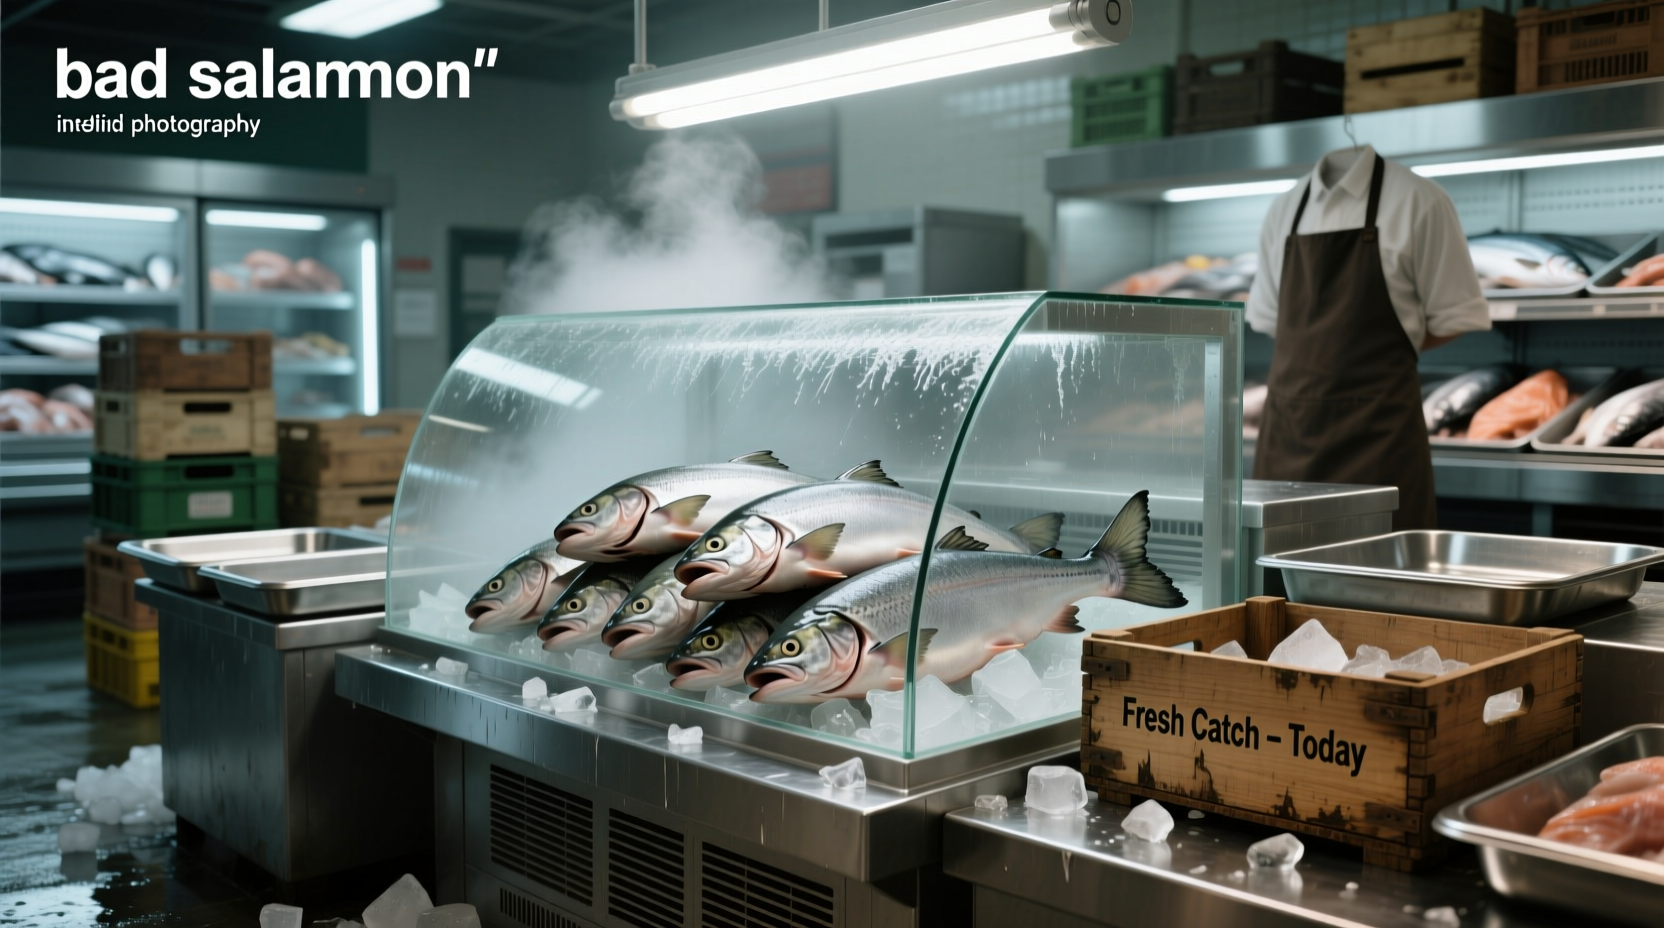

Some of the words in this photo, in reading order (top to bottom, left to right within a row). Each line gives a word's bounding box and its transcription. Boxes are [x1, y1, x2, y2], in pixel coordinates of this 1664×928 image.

[1122, 696, 1184, 737] Fresh
[1191, 707, 1260, 750] Catch
[1288, 722, 1367, 778] Today
